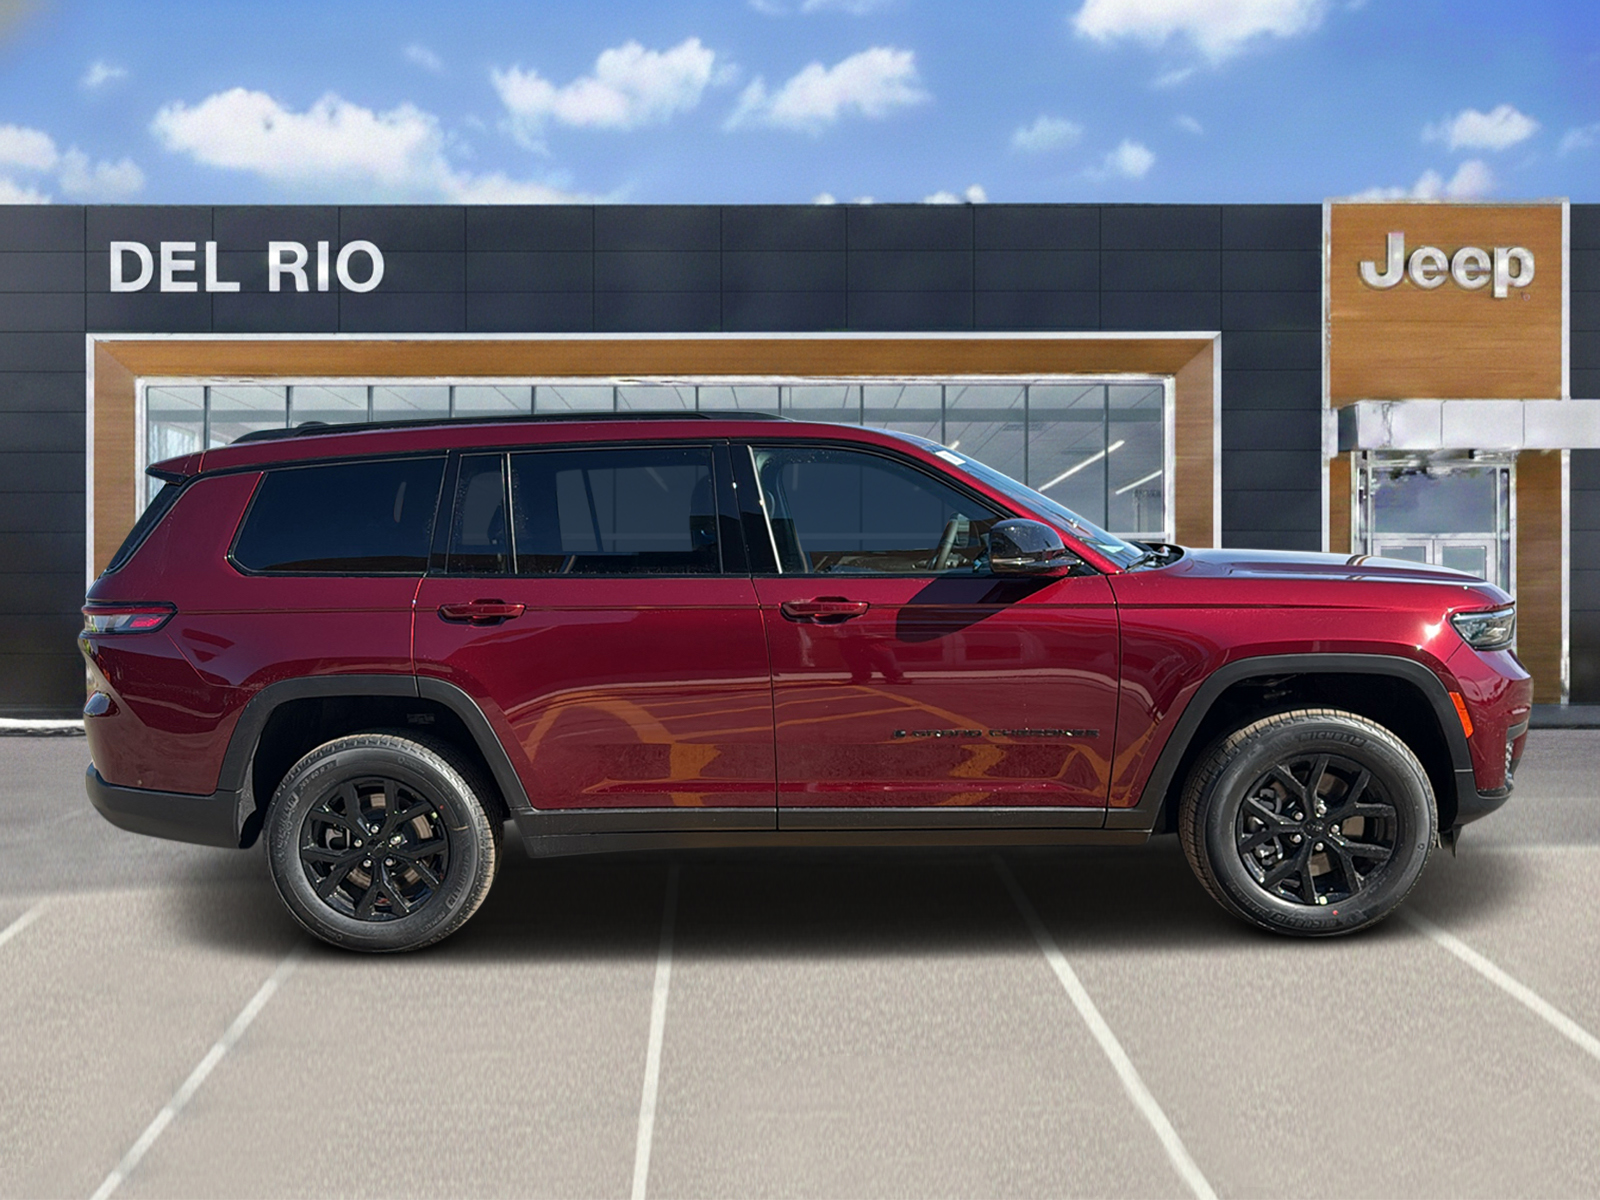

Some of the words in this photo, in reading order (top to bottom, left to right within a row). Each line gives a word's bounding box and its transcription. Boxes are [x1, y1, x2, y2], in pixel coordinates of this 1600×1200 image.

[110, 241, 241, 293] DEL
[268, 240, 385, 293] RIO
[1359, 231, 1535, 298] Jeep
[1299, 731, 1364, 747] MICHELIN
